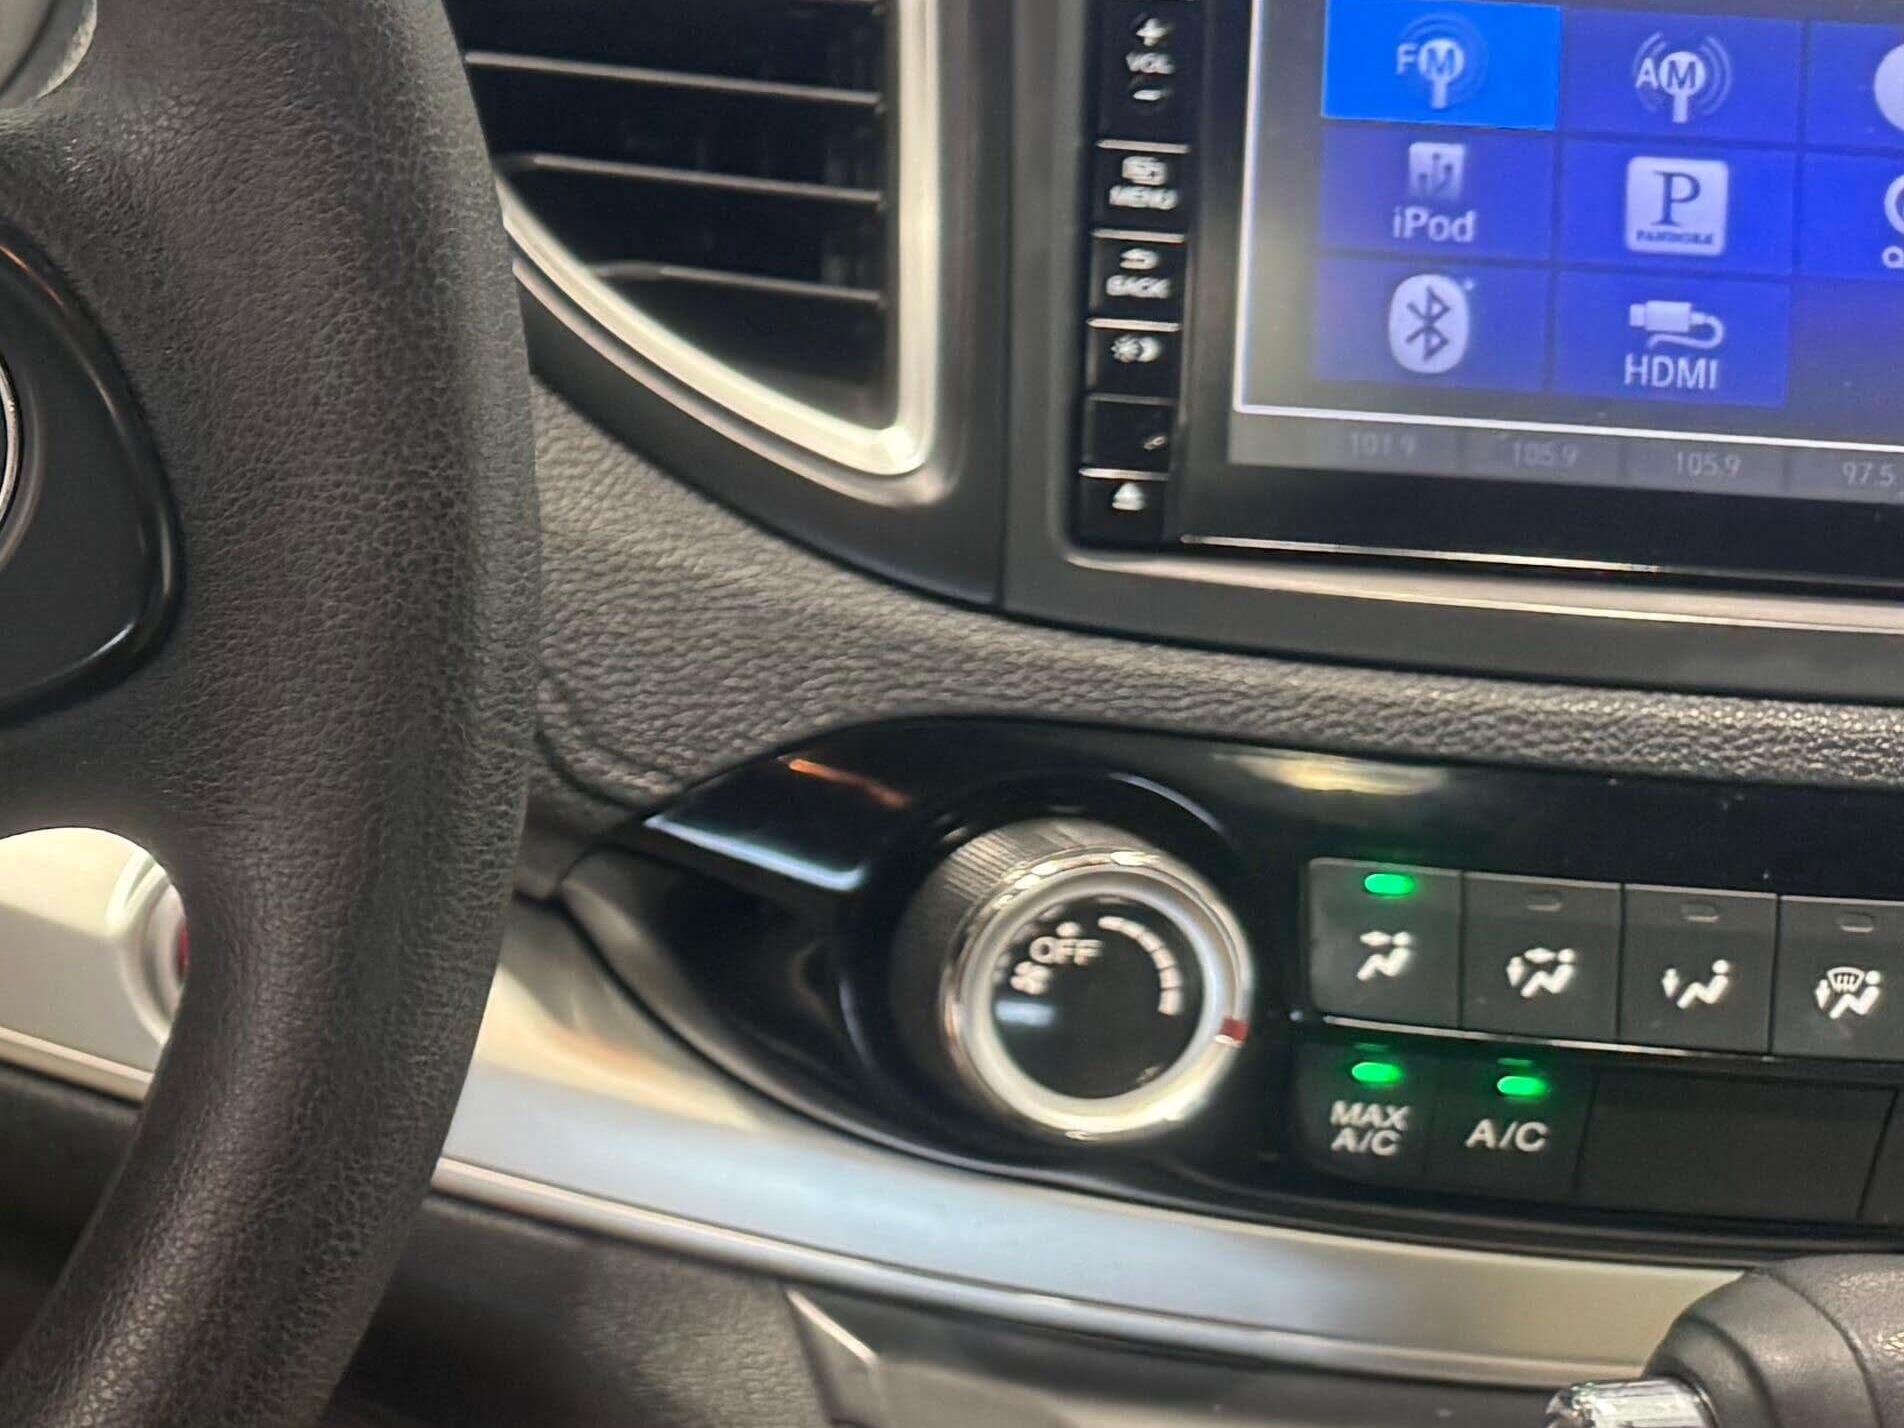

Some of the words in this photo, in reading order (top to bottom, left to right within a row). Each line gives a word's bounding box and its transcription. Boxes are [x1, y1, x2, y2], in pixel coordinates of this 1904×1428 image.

[1125, 51, 1176, 74] VOL
[1397, 39, 1464, 80] FM
[1635, 51, 1704, 91] AM
[1652, 172, 1700, 228] P
[1394, 207, 1476, 244] iPod
[1635, 229, 1713, 247] PANDORA
[1106, 274, 1171, 299] BACK
[1624, 354, 1719, 391] HDMI
[1350, 430, 1417, 460] 101.9
[1512, 440, 1579, 469] 105.9
[1676, 451, 1741, 479] 105.9
[1842, 461, 1898, 488] 97.5
[1029, 936, 1103, 965] OFF
[1329, 1100, 1410, 1132] MAX
[1331, 1126, 1402, 1158] A/C
[1465, 1118, 1550, 1152] A/C
